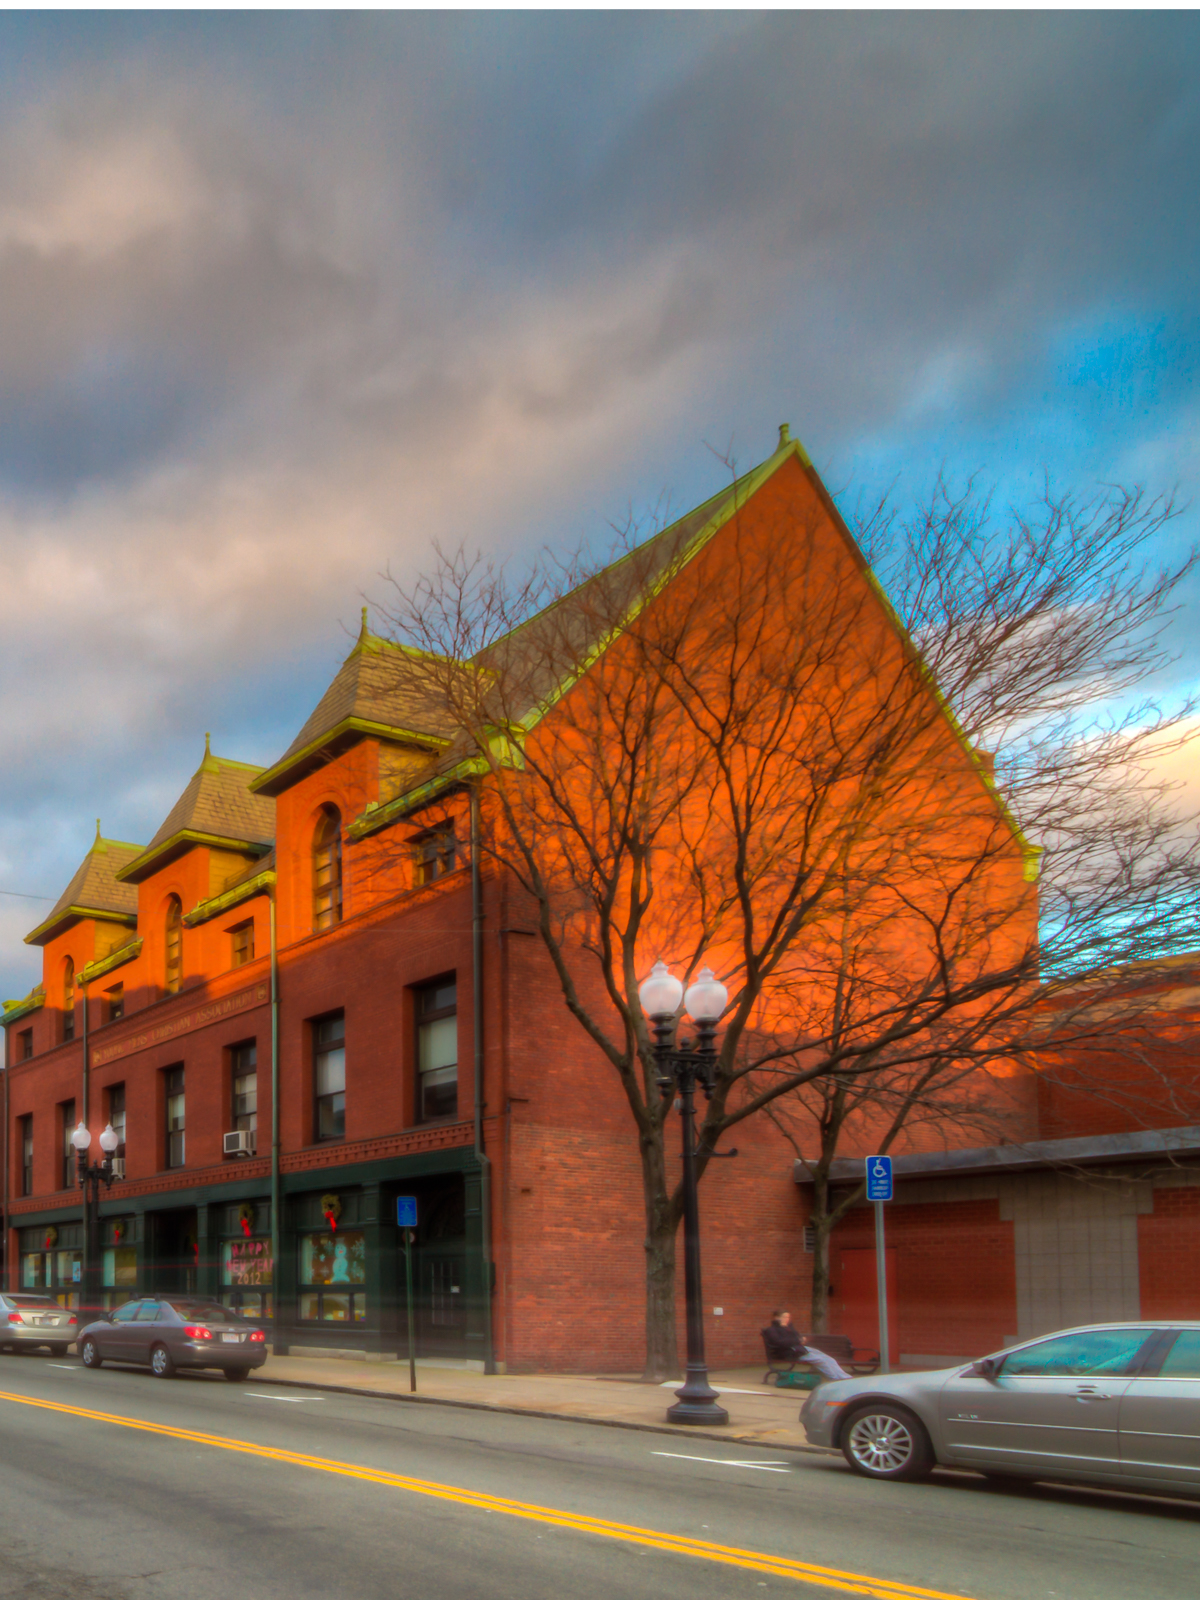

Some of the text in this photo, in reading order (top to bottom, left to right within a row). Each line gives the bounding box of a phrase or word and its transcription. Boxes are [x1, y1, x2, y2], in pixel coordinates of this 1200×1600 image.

[151, 1015, 191, 1041] CHRISTIAN
[195, 992, 253, 1024] ASSOCIATION
[231, 1241, 269, 1258] HAPPY
[226, 1258, 247, 1273] NEW
[237, 1271, 262, 1286] 2012
